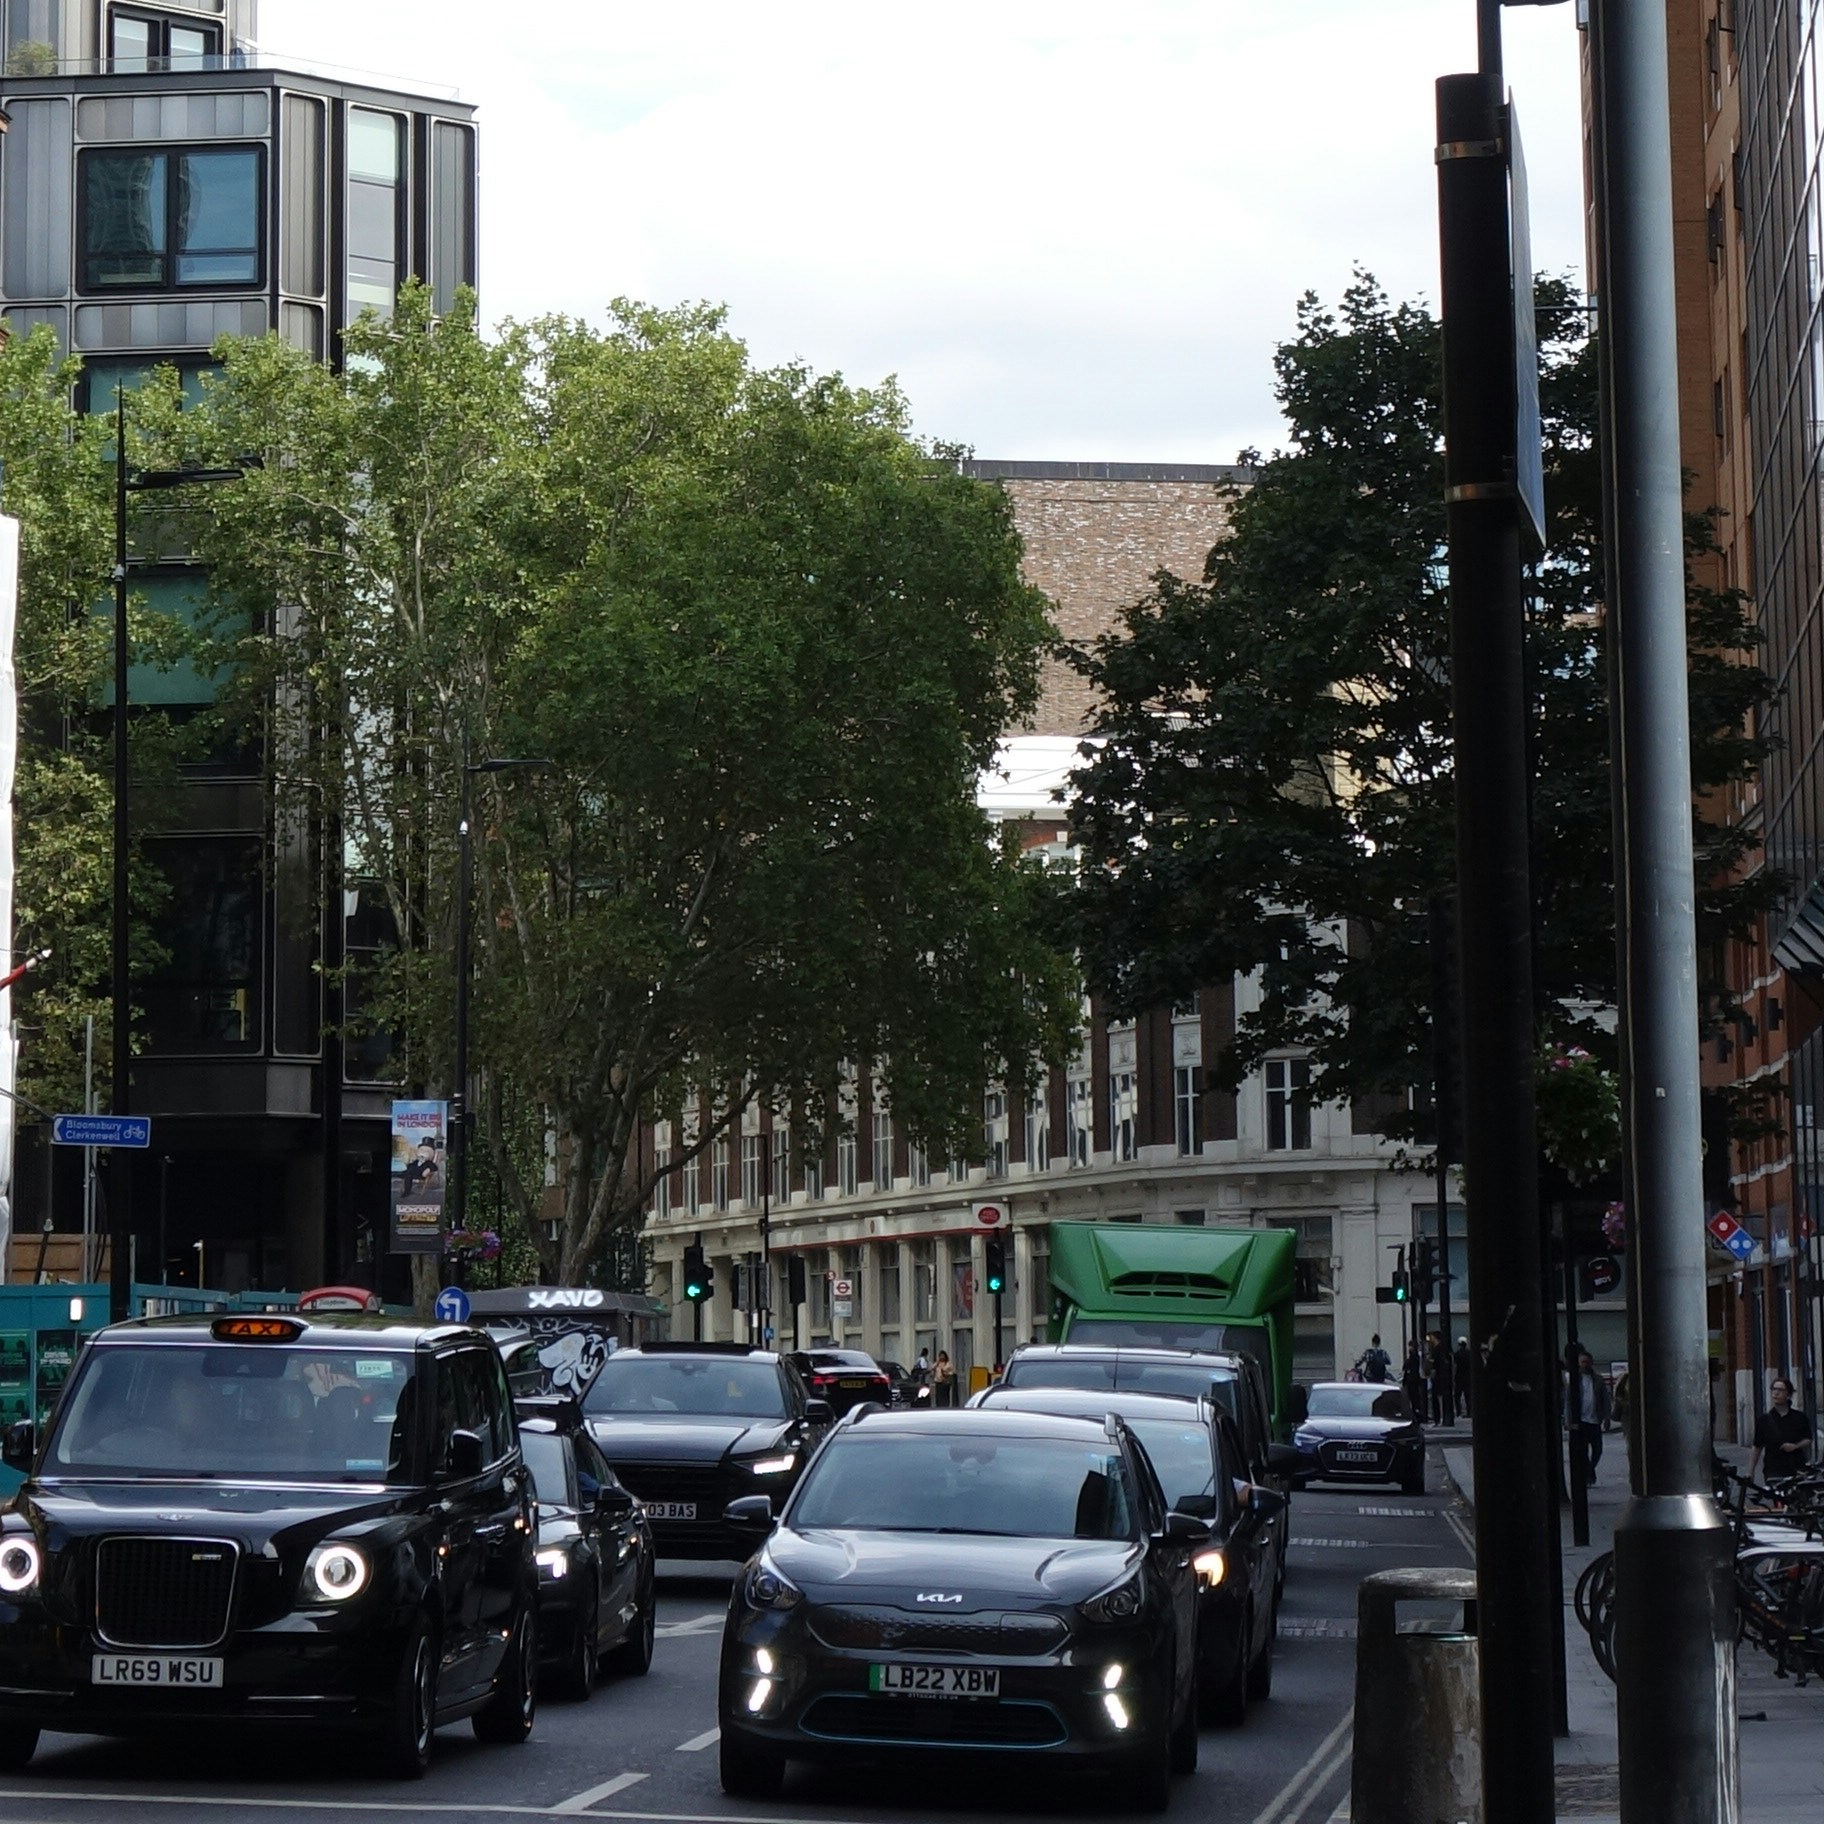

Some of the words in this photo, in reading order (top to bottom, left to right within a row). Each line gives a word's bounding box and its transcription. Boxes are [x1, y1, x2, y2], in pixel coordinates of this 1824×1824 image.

[66, 1119, 122, 1131] Bloomsbury
[65, 1130, 120, 1141] Clerkenwell
[227, 1323, 285, 1335] TAXI
[648, 1504, 665, 1516] 03
[669, 1504, 694, 1517] BAS
[100, 1659, 160, 1681] LR69
[168, 1661, 213, 1683] WSU
[885, 1666, 945, 1690] LB22
[952, 1669, 997, 1693] XBW
